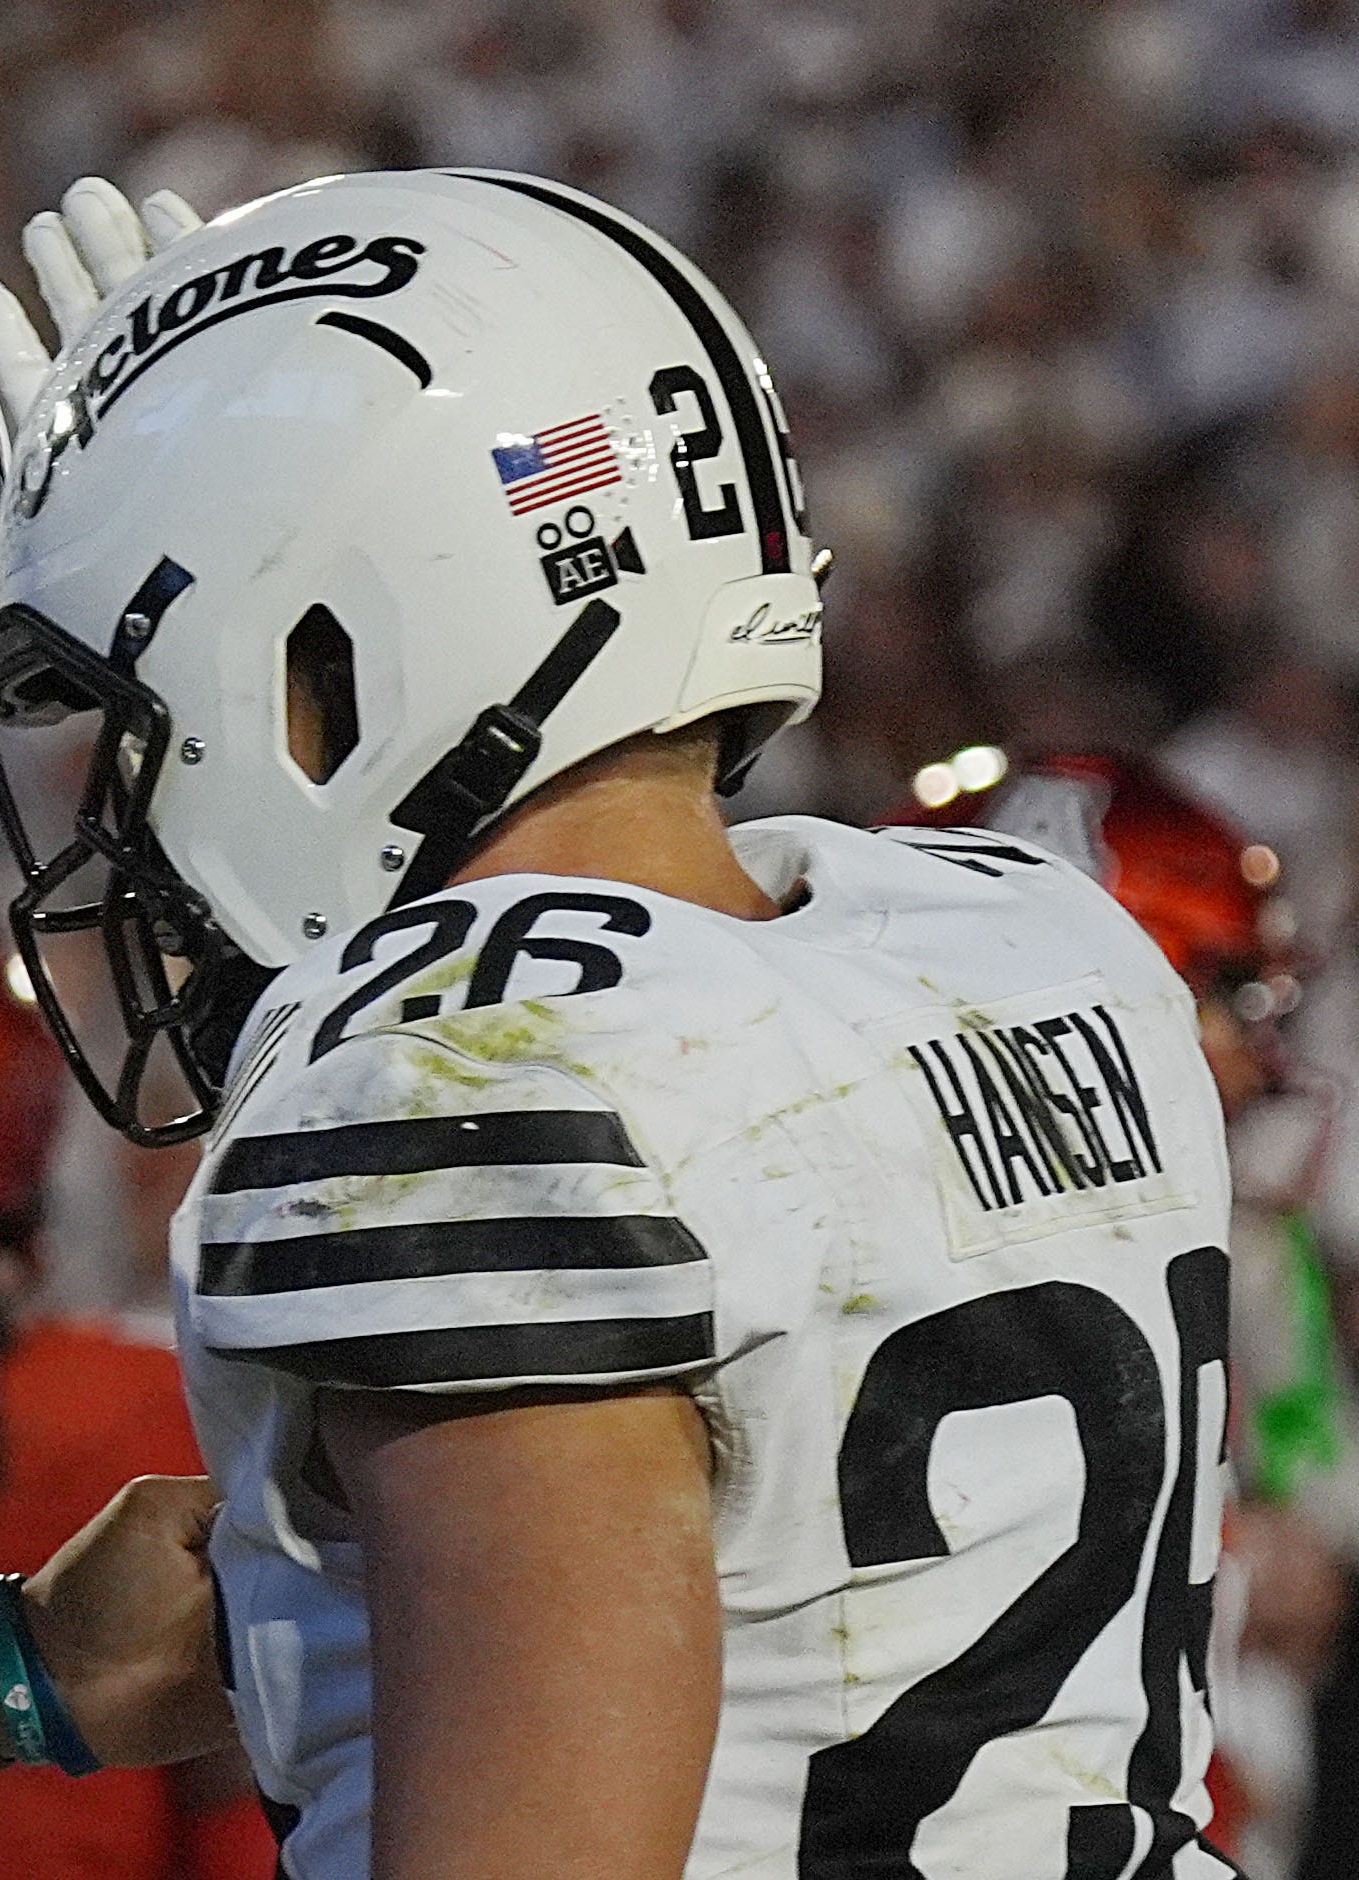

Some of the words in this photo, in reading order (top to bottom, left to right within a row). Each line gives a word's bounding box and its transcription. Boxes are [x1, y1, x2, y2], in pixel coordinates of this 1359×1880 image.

[554, 547, 611, 594] AE
[307, 891, 652, 1067] 26
[906, 1004, 1164, 1212] HANSEN
